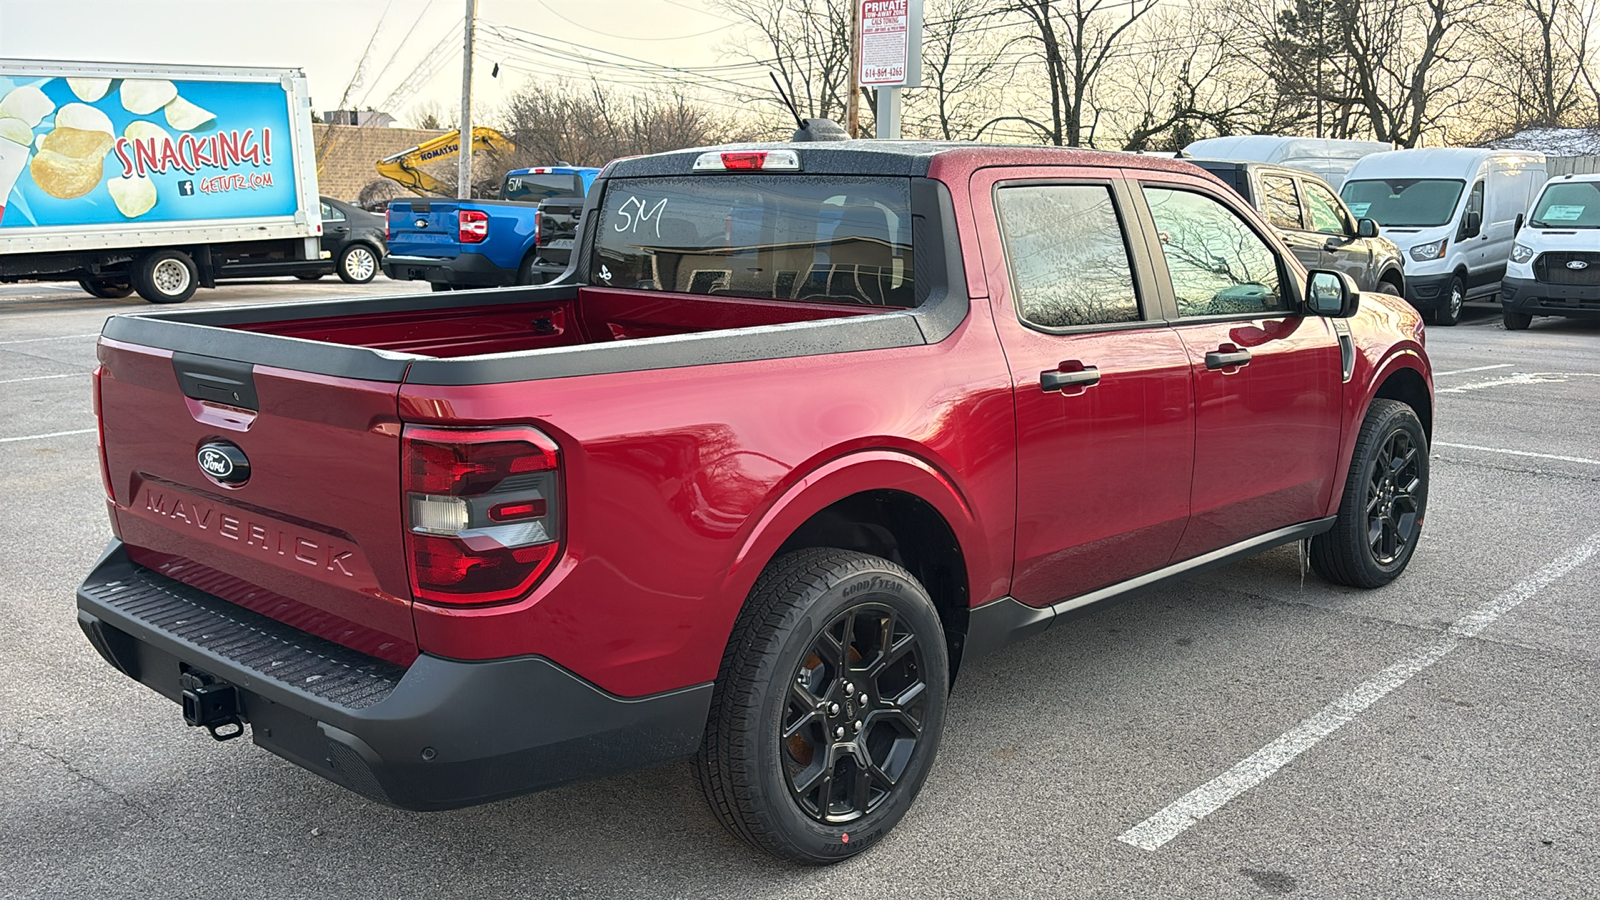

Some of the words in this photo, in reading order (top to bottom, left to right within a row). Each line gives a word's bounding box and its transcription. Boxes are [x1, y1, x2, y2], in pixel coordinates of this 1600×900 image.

[864, 0, 906, 12] PRIVATE
[865, 10, 893, 18] TOW-AWAY
[115, 128, 272, 176] SNACKING!
[420, 144, 459, 161] KOMATSU
[200, 172, 273, 193] GETUTZ.COM
[202, 450, 227, 474] Ford
[146, 489, 353, 577] MAVERICK
